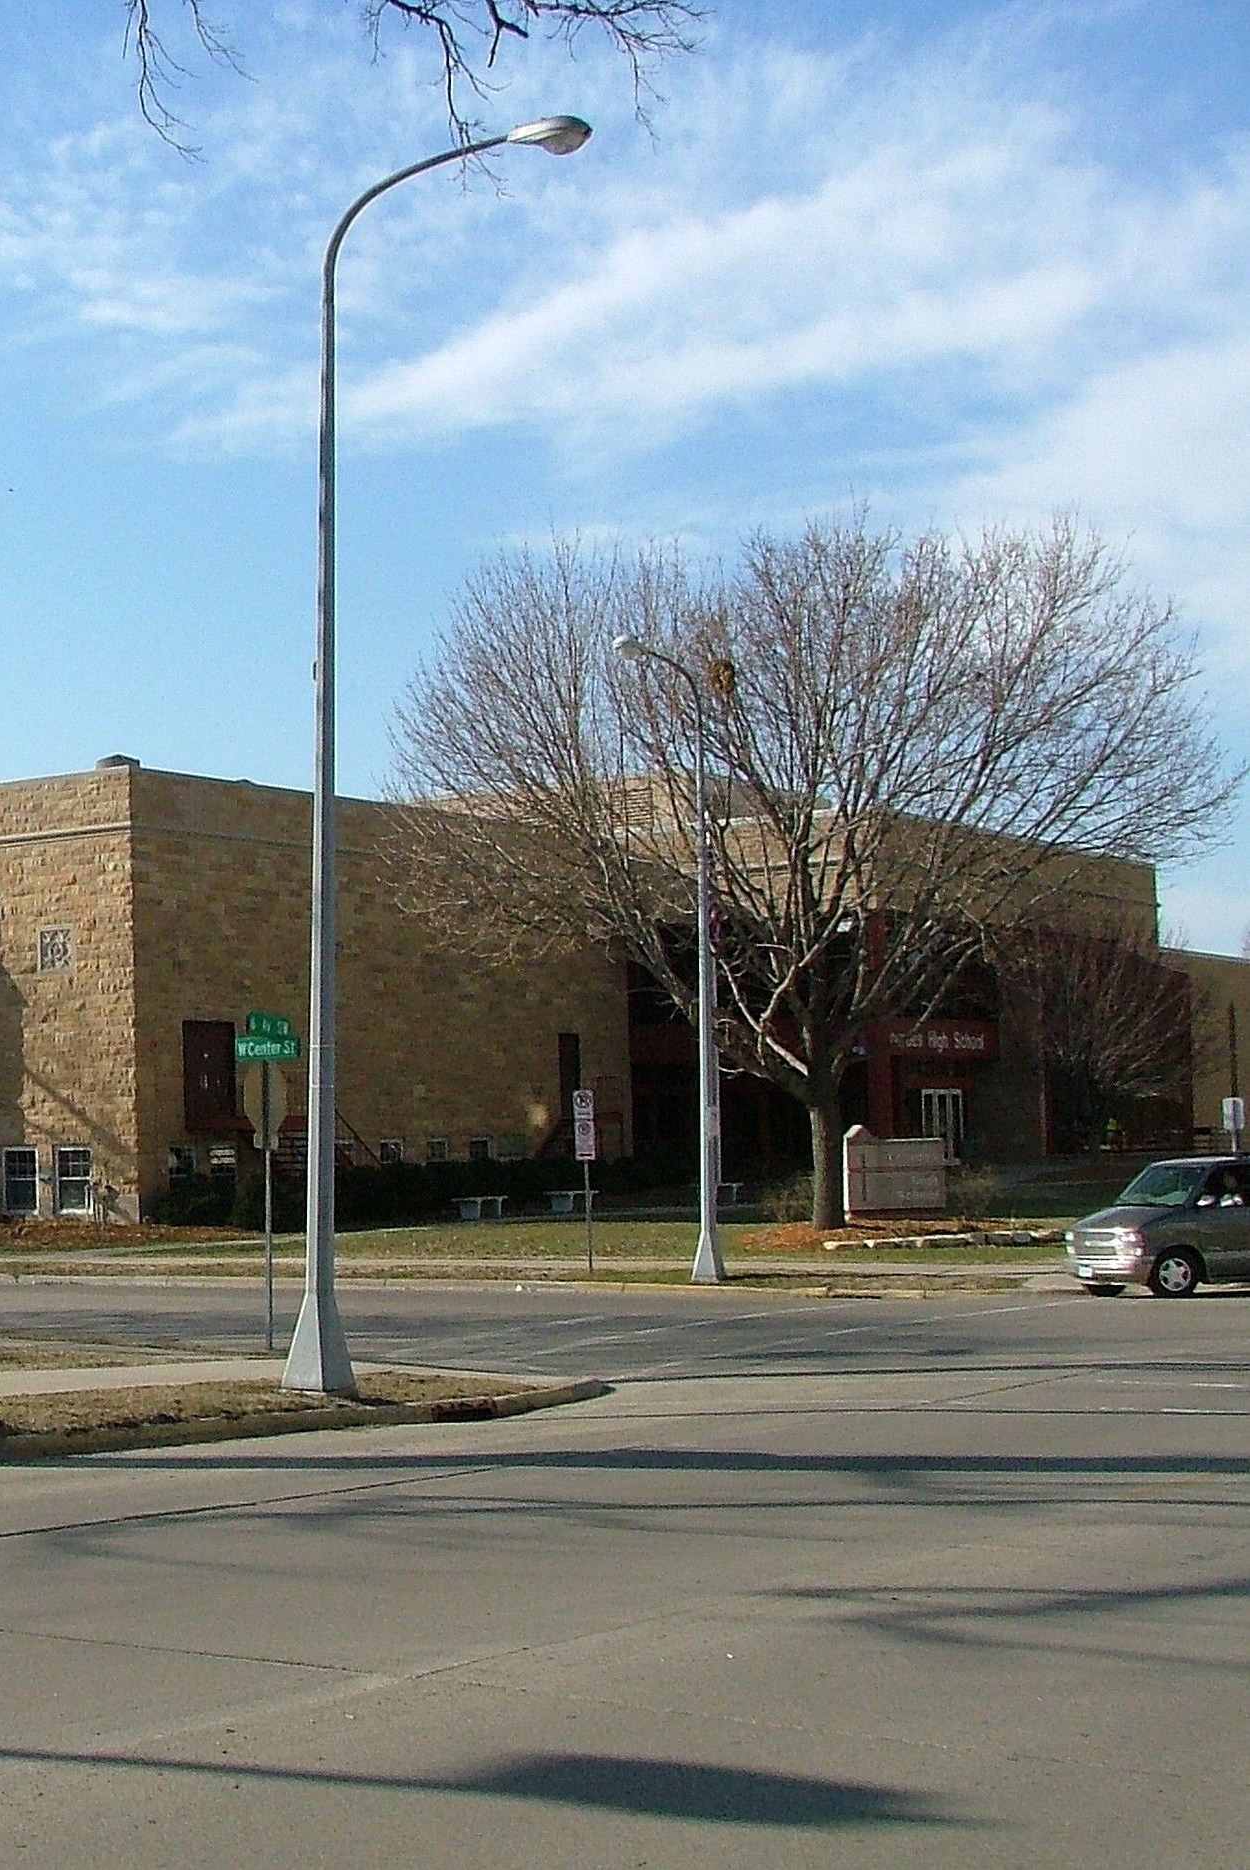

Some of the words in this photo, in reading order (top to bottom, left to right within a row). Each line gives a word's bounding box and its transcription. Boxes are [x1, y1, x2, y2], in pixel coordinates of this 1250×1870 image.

[237, 1042, 246, 1056] W
[247, 1041, 282, 1056] Center
[283, 1040, 295, 1054] St
[953, 1031, 985, 1051] School
